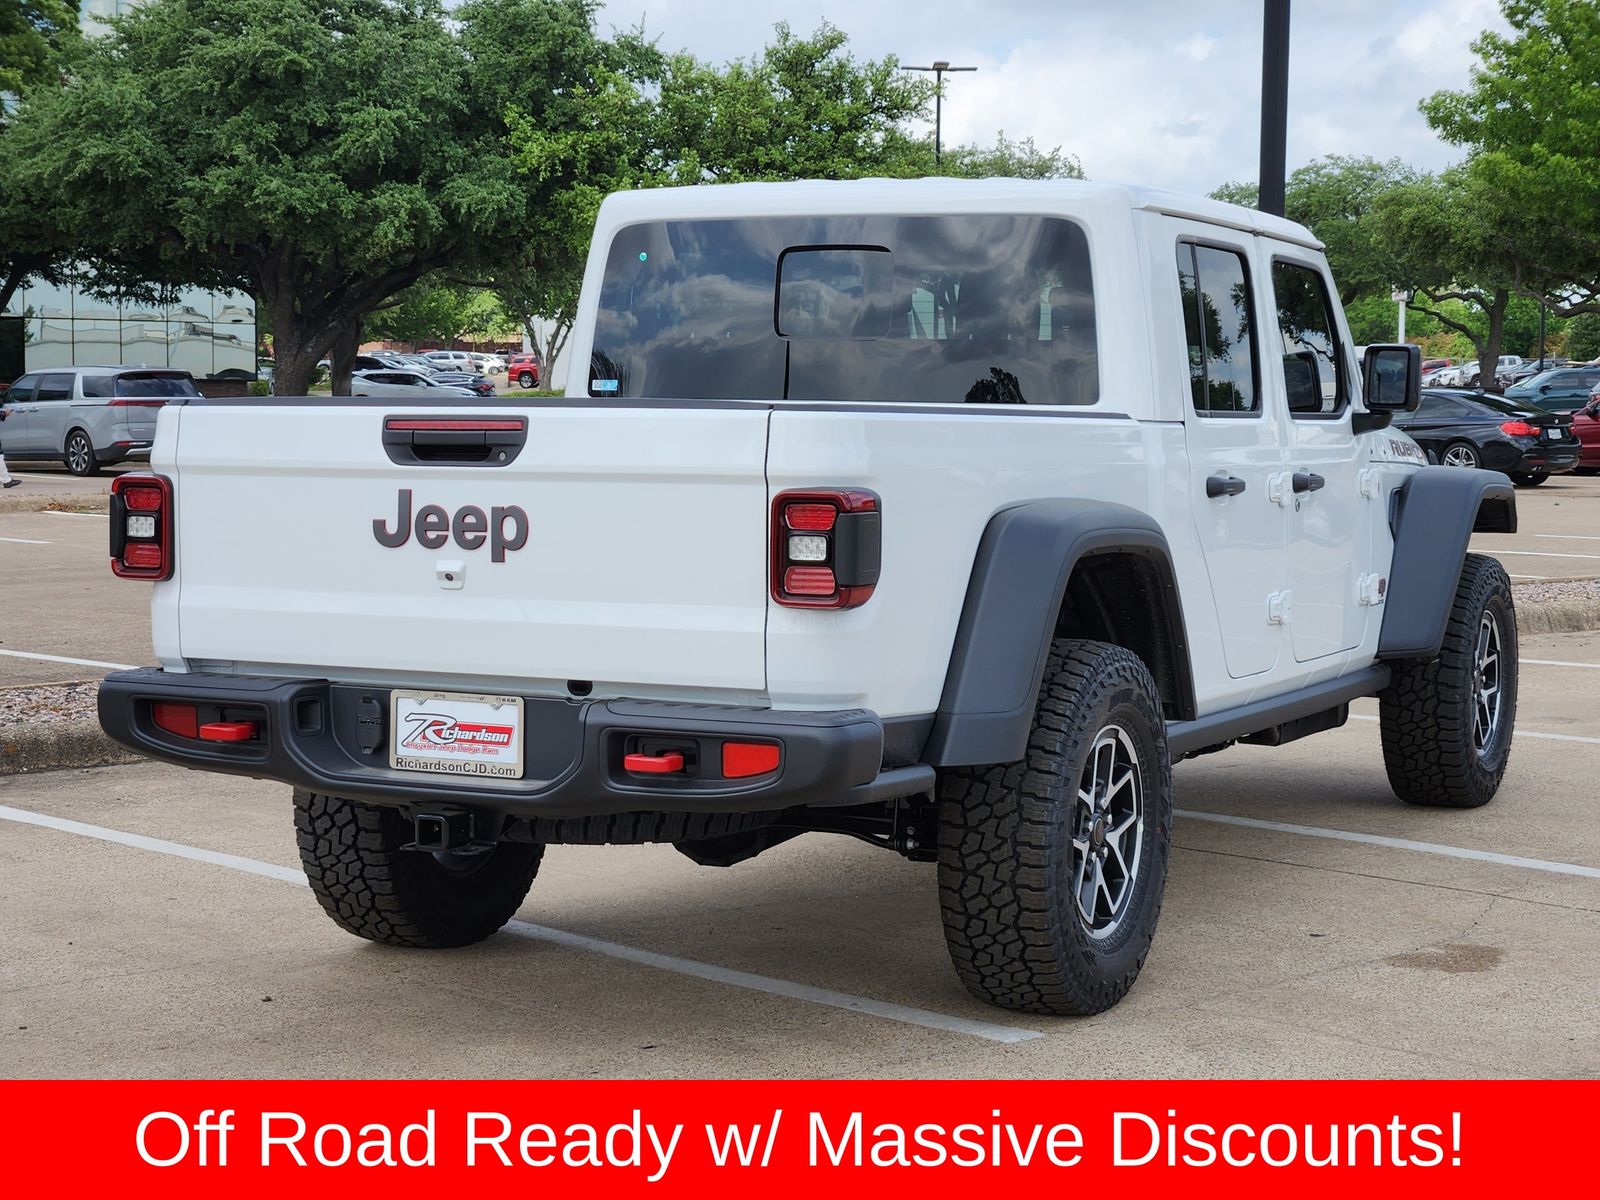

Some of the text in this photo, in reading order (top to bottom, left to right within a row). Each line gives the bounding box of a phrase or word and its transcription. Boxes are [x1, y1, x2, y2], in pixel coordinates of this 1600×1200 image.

[372, 488, 529, 564] Jeep
[402, 712, 510, 747] Richardson
[395, 757, 517, 777] RichardsonCJD.com
